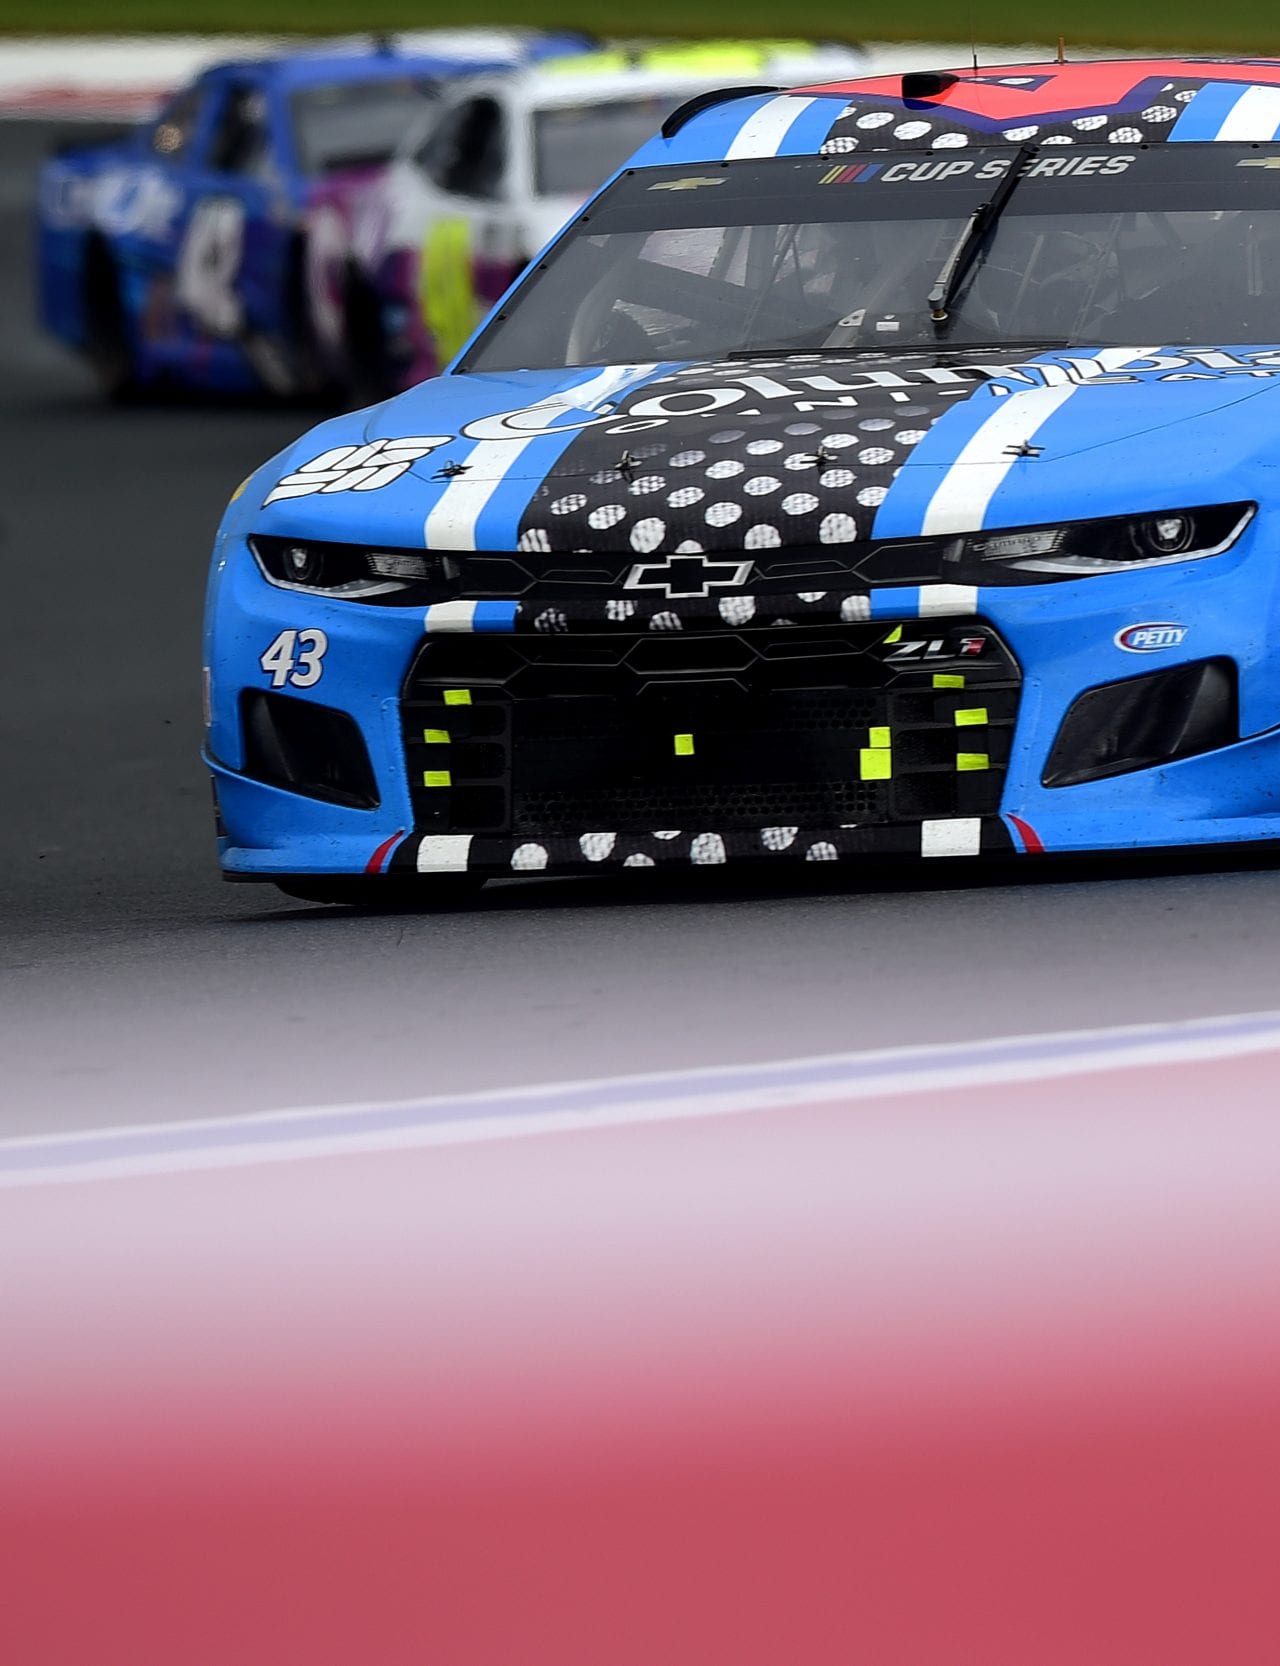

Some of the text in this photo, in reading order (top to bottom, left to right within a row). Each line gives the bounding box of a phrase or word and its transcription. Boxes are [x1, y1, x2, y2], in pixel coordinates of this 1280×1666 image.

[880, 160, 975, 183] CUP
[882, 637, 987, 662] ZL1
[1132, 628, 1189, 647] PETTY
[260, 628, 329, 688] 43
